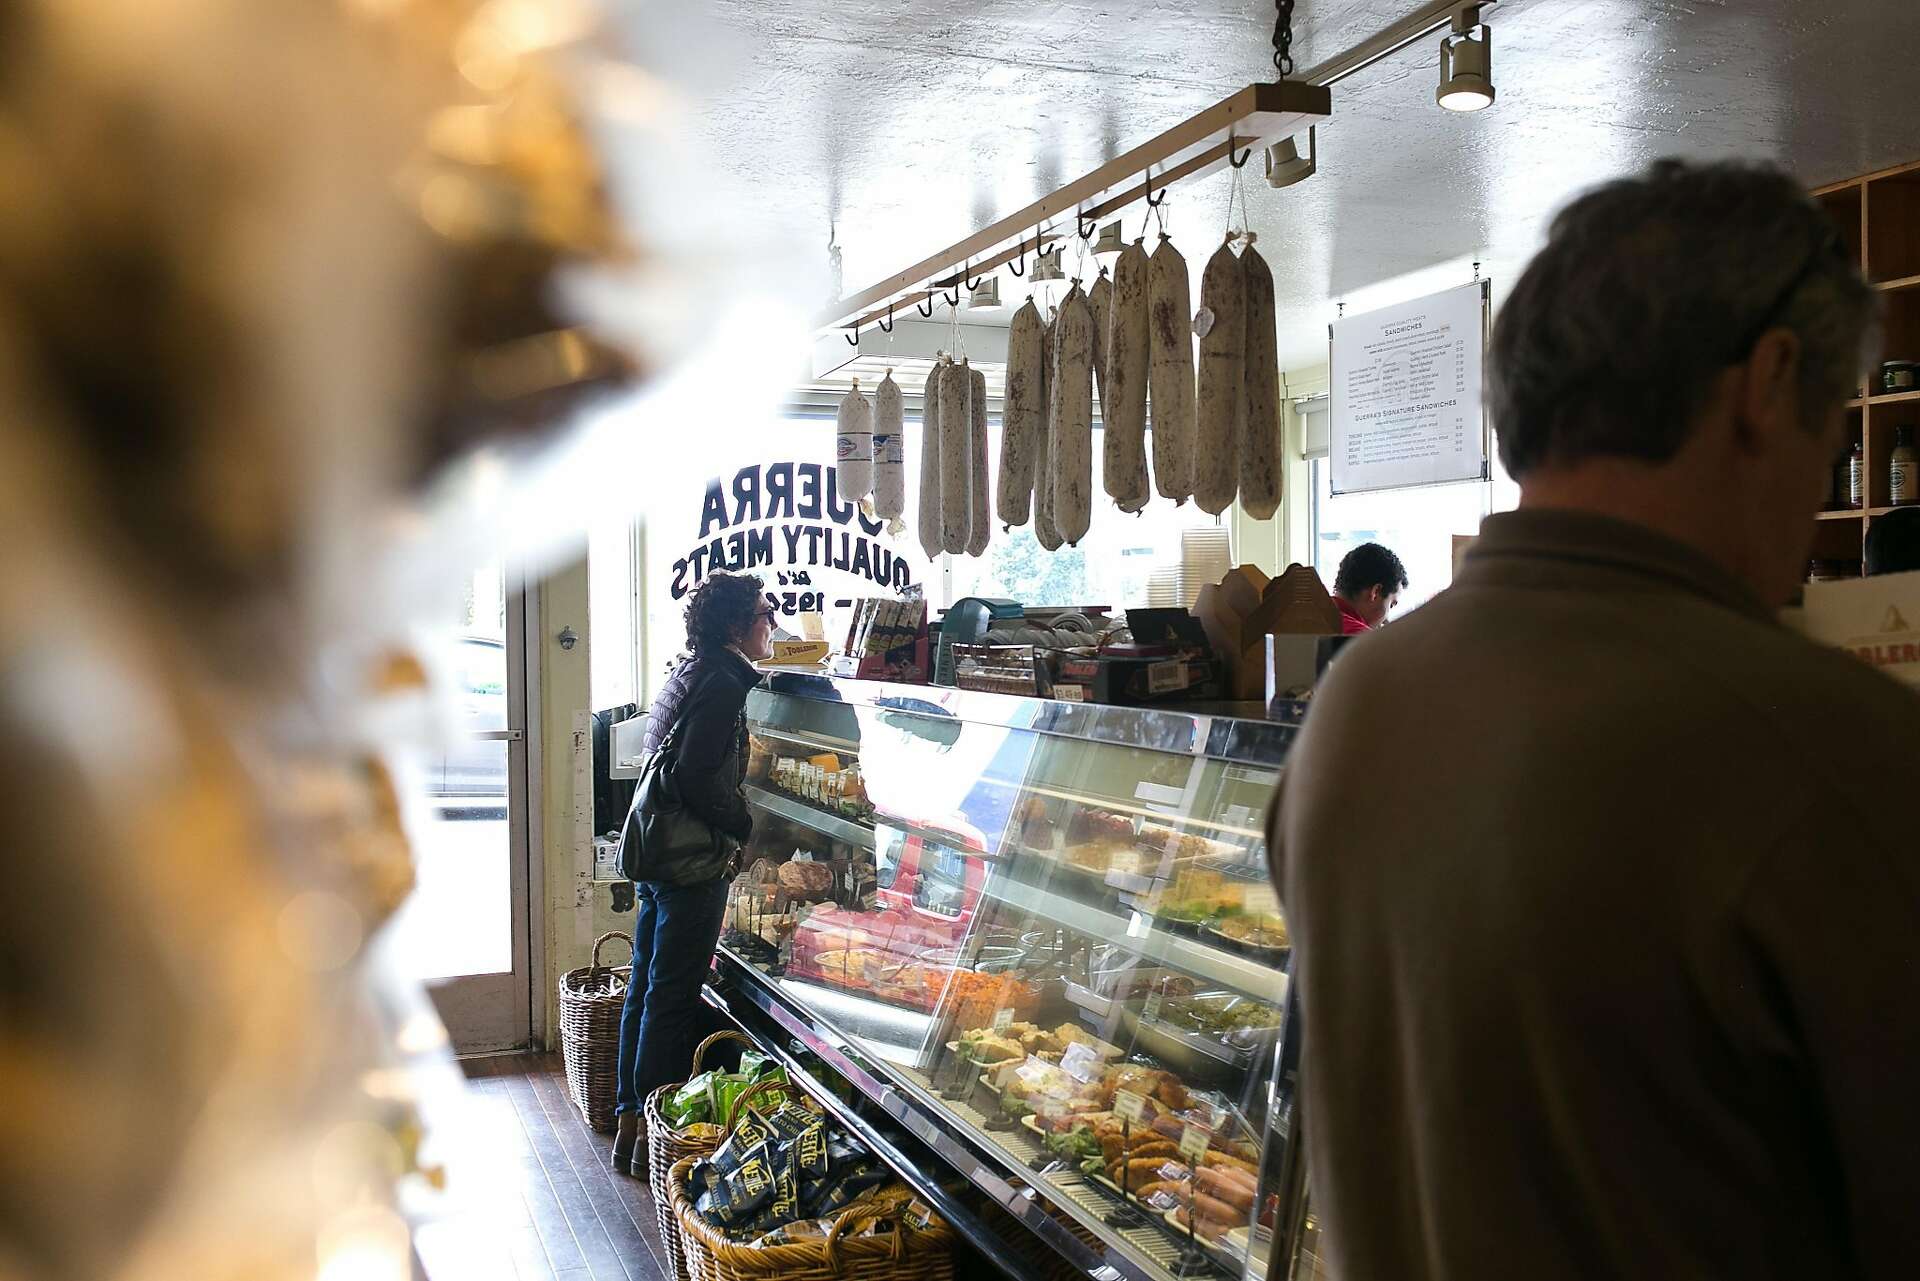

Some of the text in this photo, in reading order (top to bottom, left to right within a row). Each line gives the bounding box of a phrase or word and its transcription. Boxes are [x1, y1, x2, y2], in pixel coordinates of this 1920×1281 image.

[1384, 322, 1423, 337] SANDWICHES
[1382, 405, 1416, 418] SIGNATURE
[1415, 399, 1457, 413] SANDWICHES
